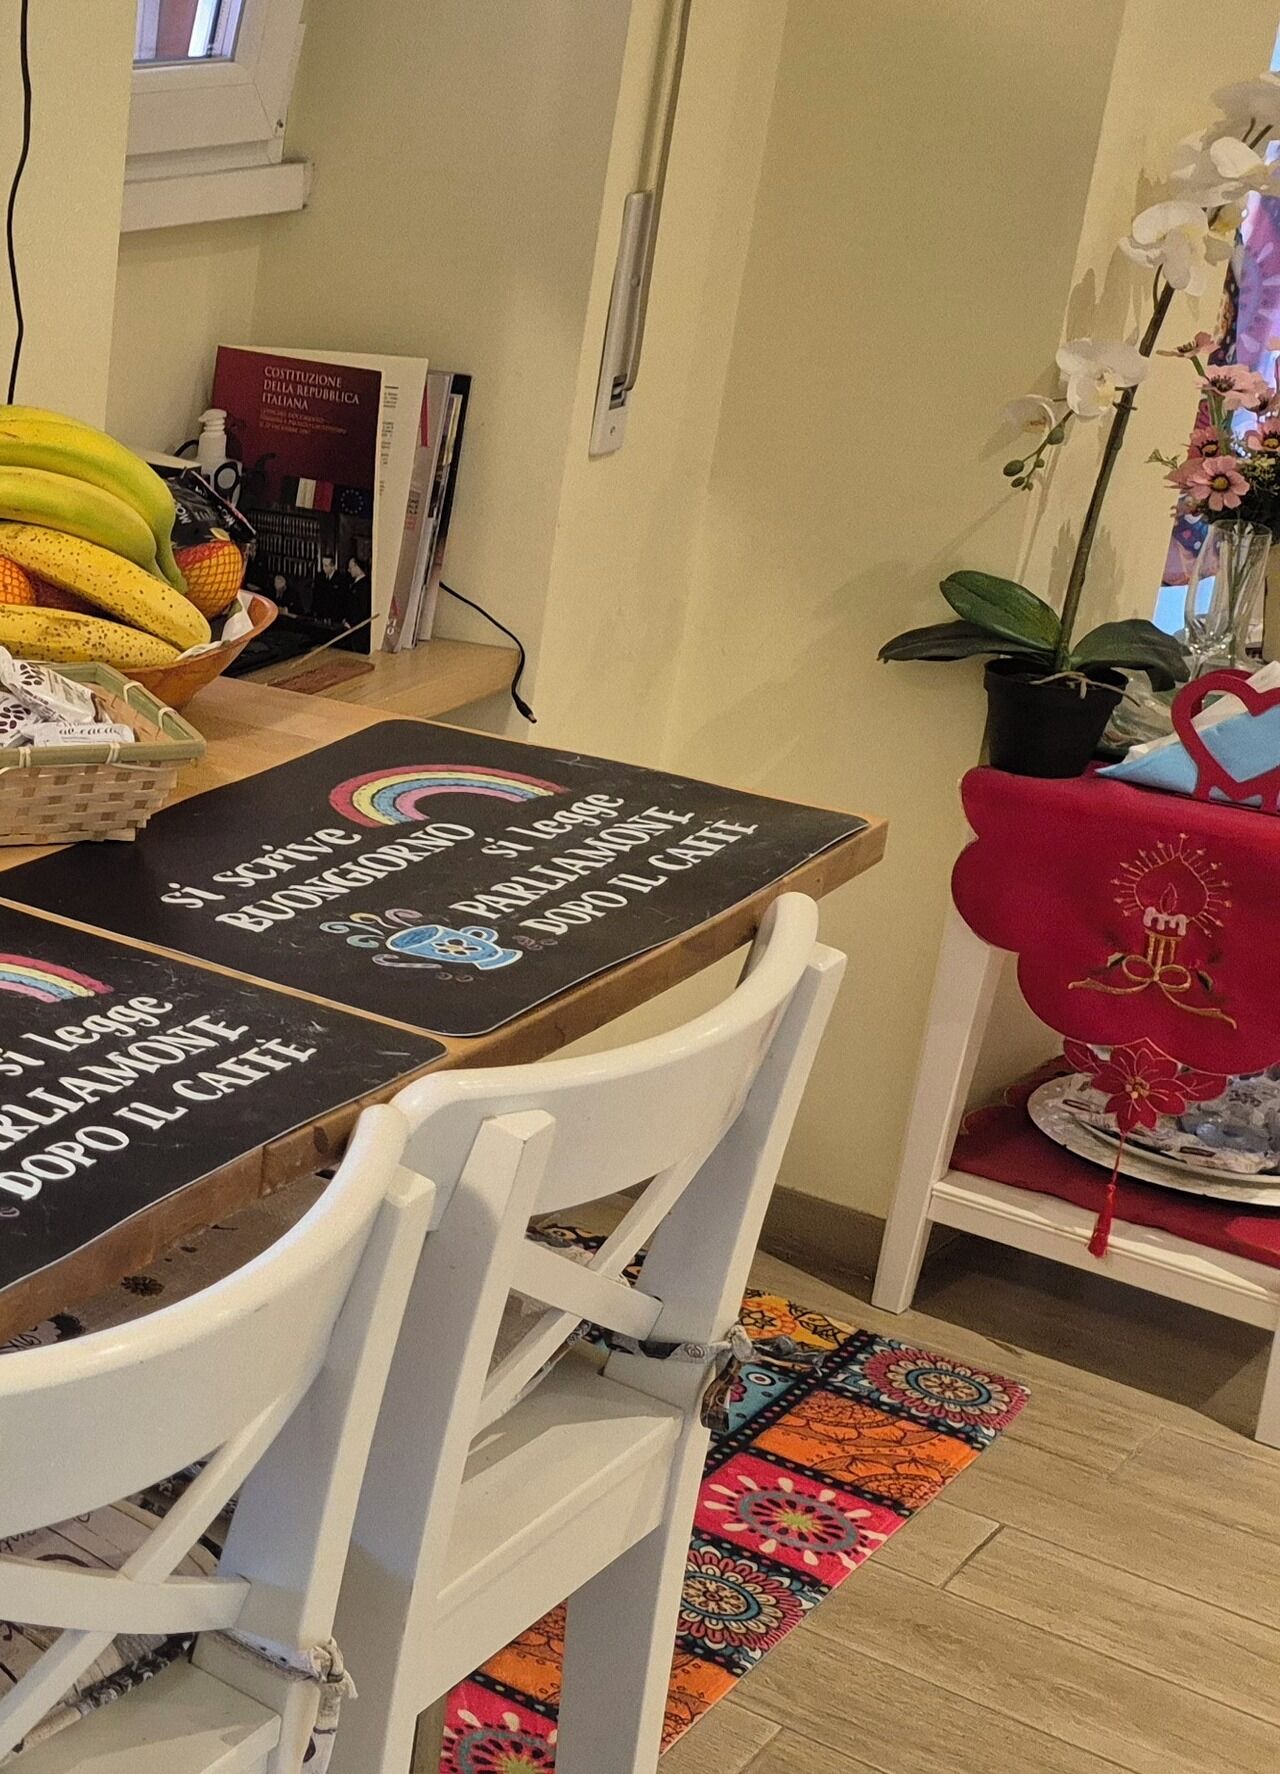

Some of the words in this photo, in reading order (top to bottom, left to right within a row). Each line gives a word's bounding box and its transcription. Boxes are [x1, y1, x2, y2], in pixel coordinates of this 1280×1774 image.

[262, 392, 309, 410] ITALIANA
[264, 379, 294, 394] DELLA
[297, 385, 359, 405] REPUBBLICA
[265, 365, 342, 388] COSTITUZIONE
[449, 805, 695, 921] PARLIAMONE
[481, 835, 519, 858] si
[519, 792, 624, 840] legge
[160, 881, 225, 910] si
[212, 825, 362, 888] scrive
[214, 822, 476, 933] BUONGIORNO
[519, 891, 629, 936] DOPO
[613, 868, 667, 897] IL
[647, 818, 759, 876] CAFFÈ
[48, 991, 174, 1060] legge
[118, 1097, 188, 1134] IL
[173, 1033, 318, 1105] CAFFÈ
